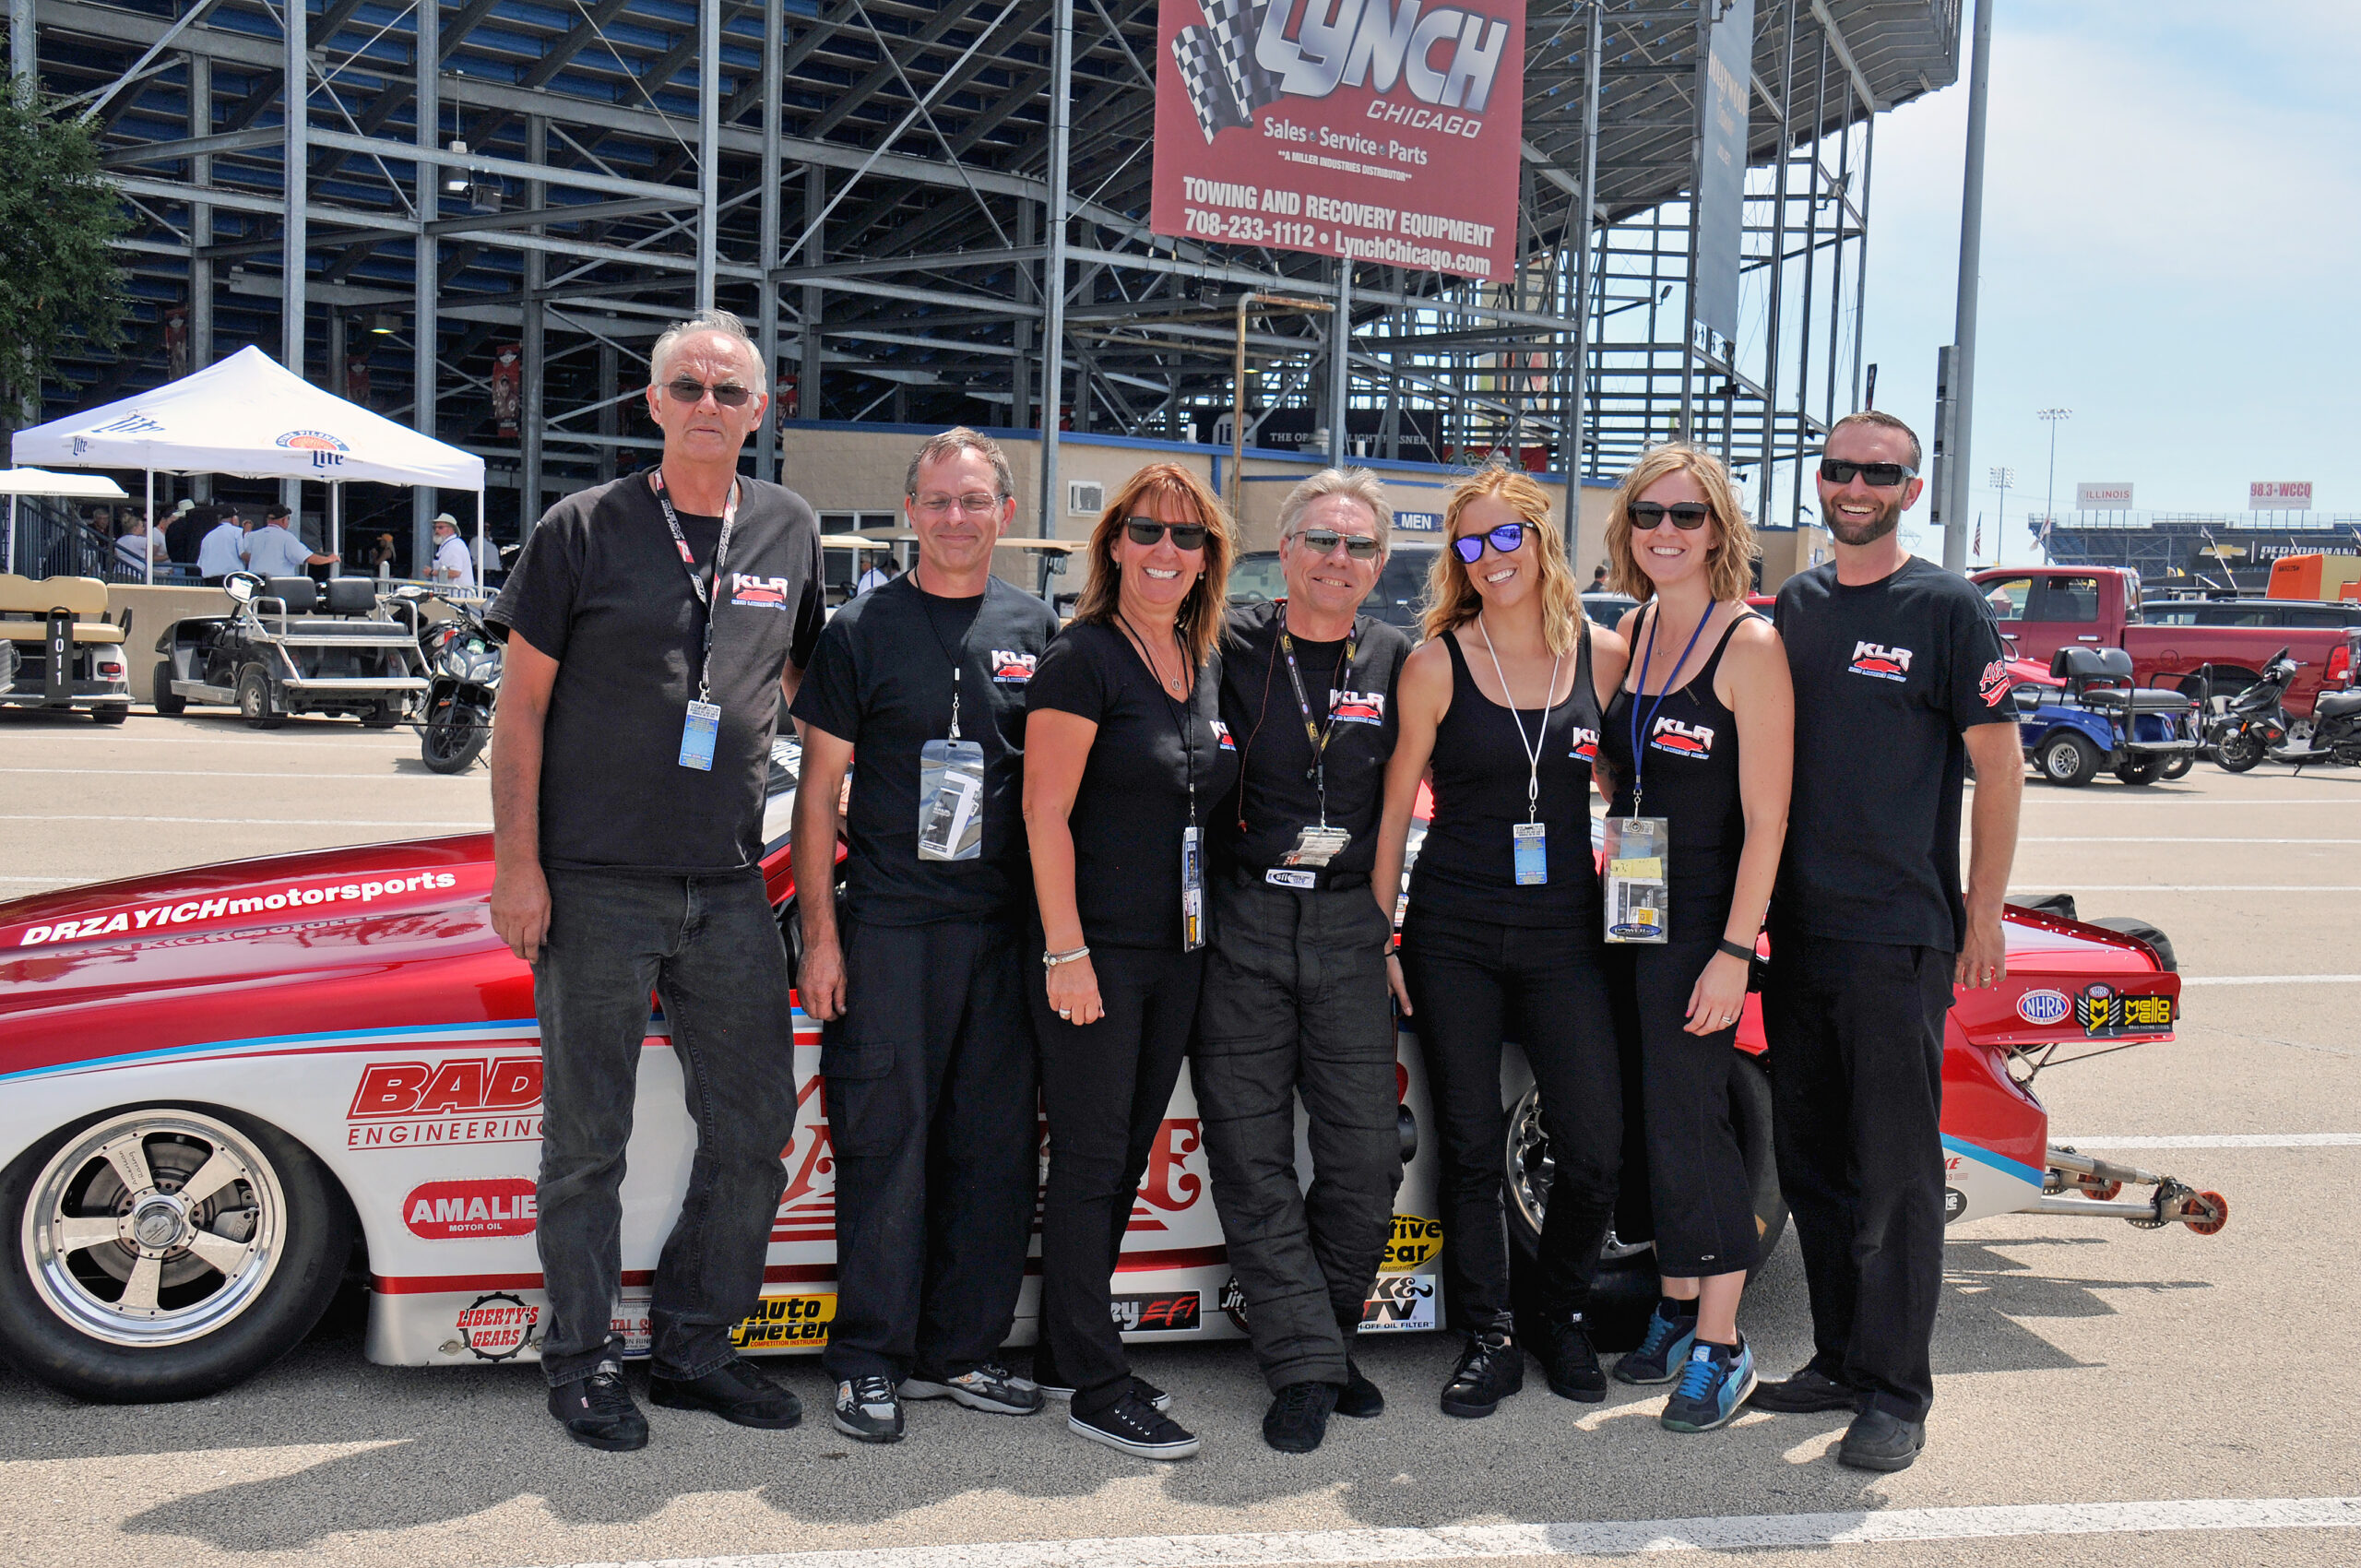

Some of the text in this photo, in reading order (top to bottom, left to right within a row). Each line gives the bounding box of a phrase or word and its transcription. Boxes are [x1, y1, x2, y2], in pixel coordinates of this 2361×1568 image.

[1255, 0, 1511, 113] LYNCH
[1367, 100, 1482, 138] CHICAGO
[1264, 116, 1428, 165] Sales Service Parts
[1292, 151, 1318, 165] MILLER
[1320, 157, 1361, 173] INDUSTRIES
[1183, 176, 1494, 248] TOWING AND RECOVERY EQUIPMENT
[1184, 208, 1490, 276] 708-233-1112 LynchChicago.com
[1270, 433, 1291, 443] THE
[313, 450, 344, 468] Lite
[2085, 490, 2130, 499] ILLINOIS
[2250, 482, 2311, 498] 98.3 WCCQ
[1401, 514, 1431, 530] MEN
[732, 572, 789, 600] KLR
[991, 649, 1038, 672] KLR
[1852, 640, 1913, 672] KLR
[1329, 689, 1385, 716] KLR
[1653, 716, 1714, 751] KLR
[2024, 991, 2061, 999] CHAMPIONSHIP
[2090, 987, 2108, 997] NHRA
[2026, 999, 2063, 1017] NHRA
[2043, 1015, 2063, 1023] RACING
[347, 1055, 543, 1120] BAD
[409, 1194, 538, 1224] AMALIE
[449, 1224, 484, 1232] MOTOR
[1389, 1218, 1442, 1240] tive
[1383, 1244, 1430, 1263] ear
[457, 1306, 539, 1327] LIBERTY'S
[750, 1298, 821, 1320] Auto
[1140, 1296, 1199, 1326] EFI
[471, 1329, 521, 1348] GEARS
[741, 1320, 829, 1347] Meter
[751, 1339, 789, 1348] COMPETITION
